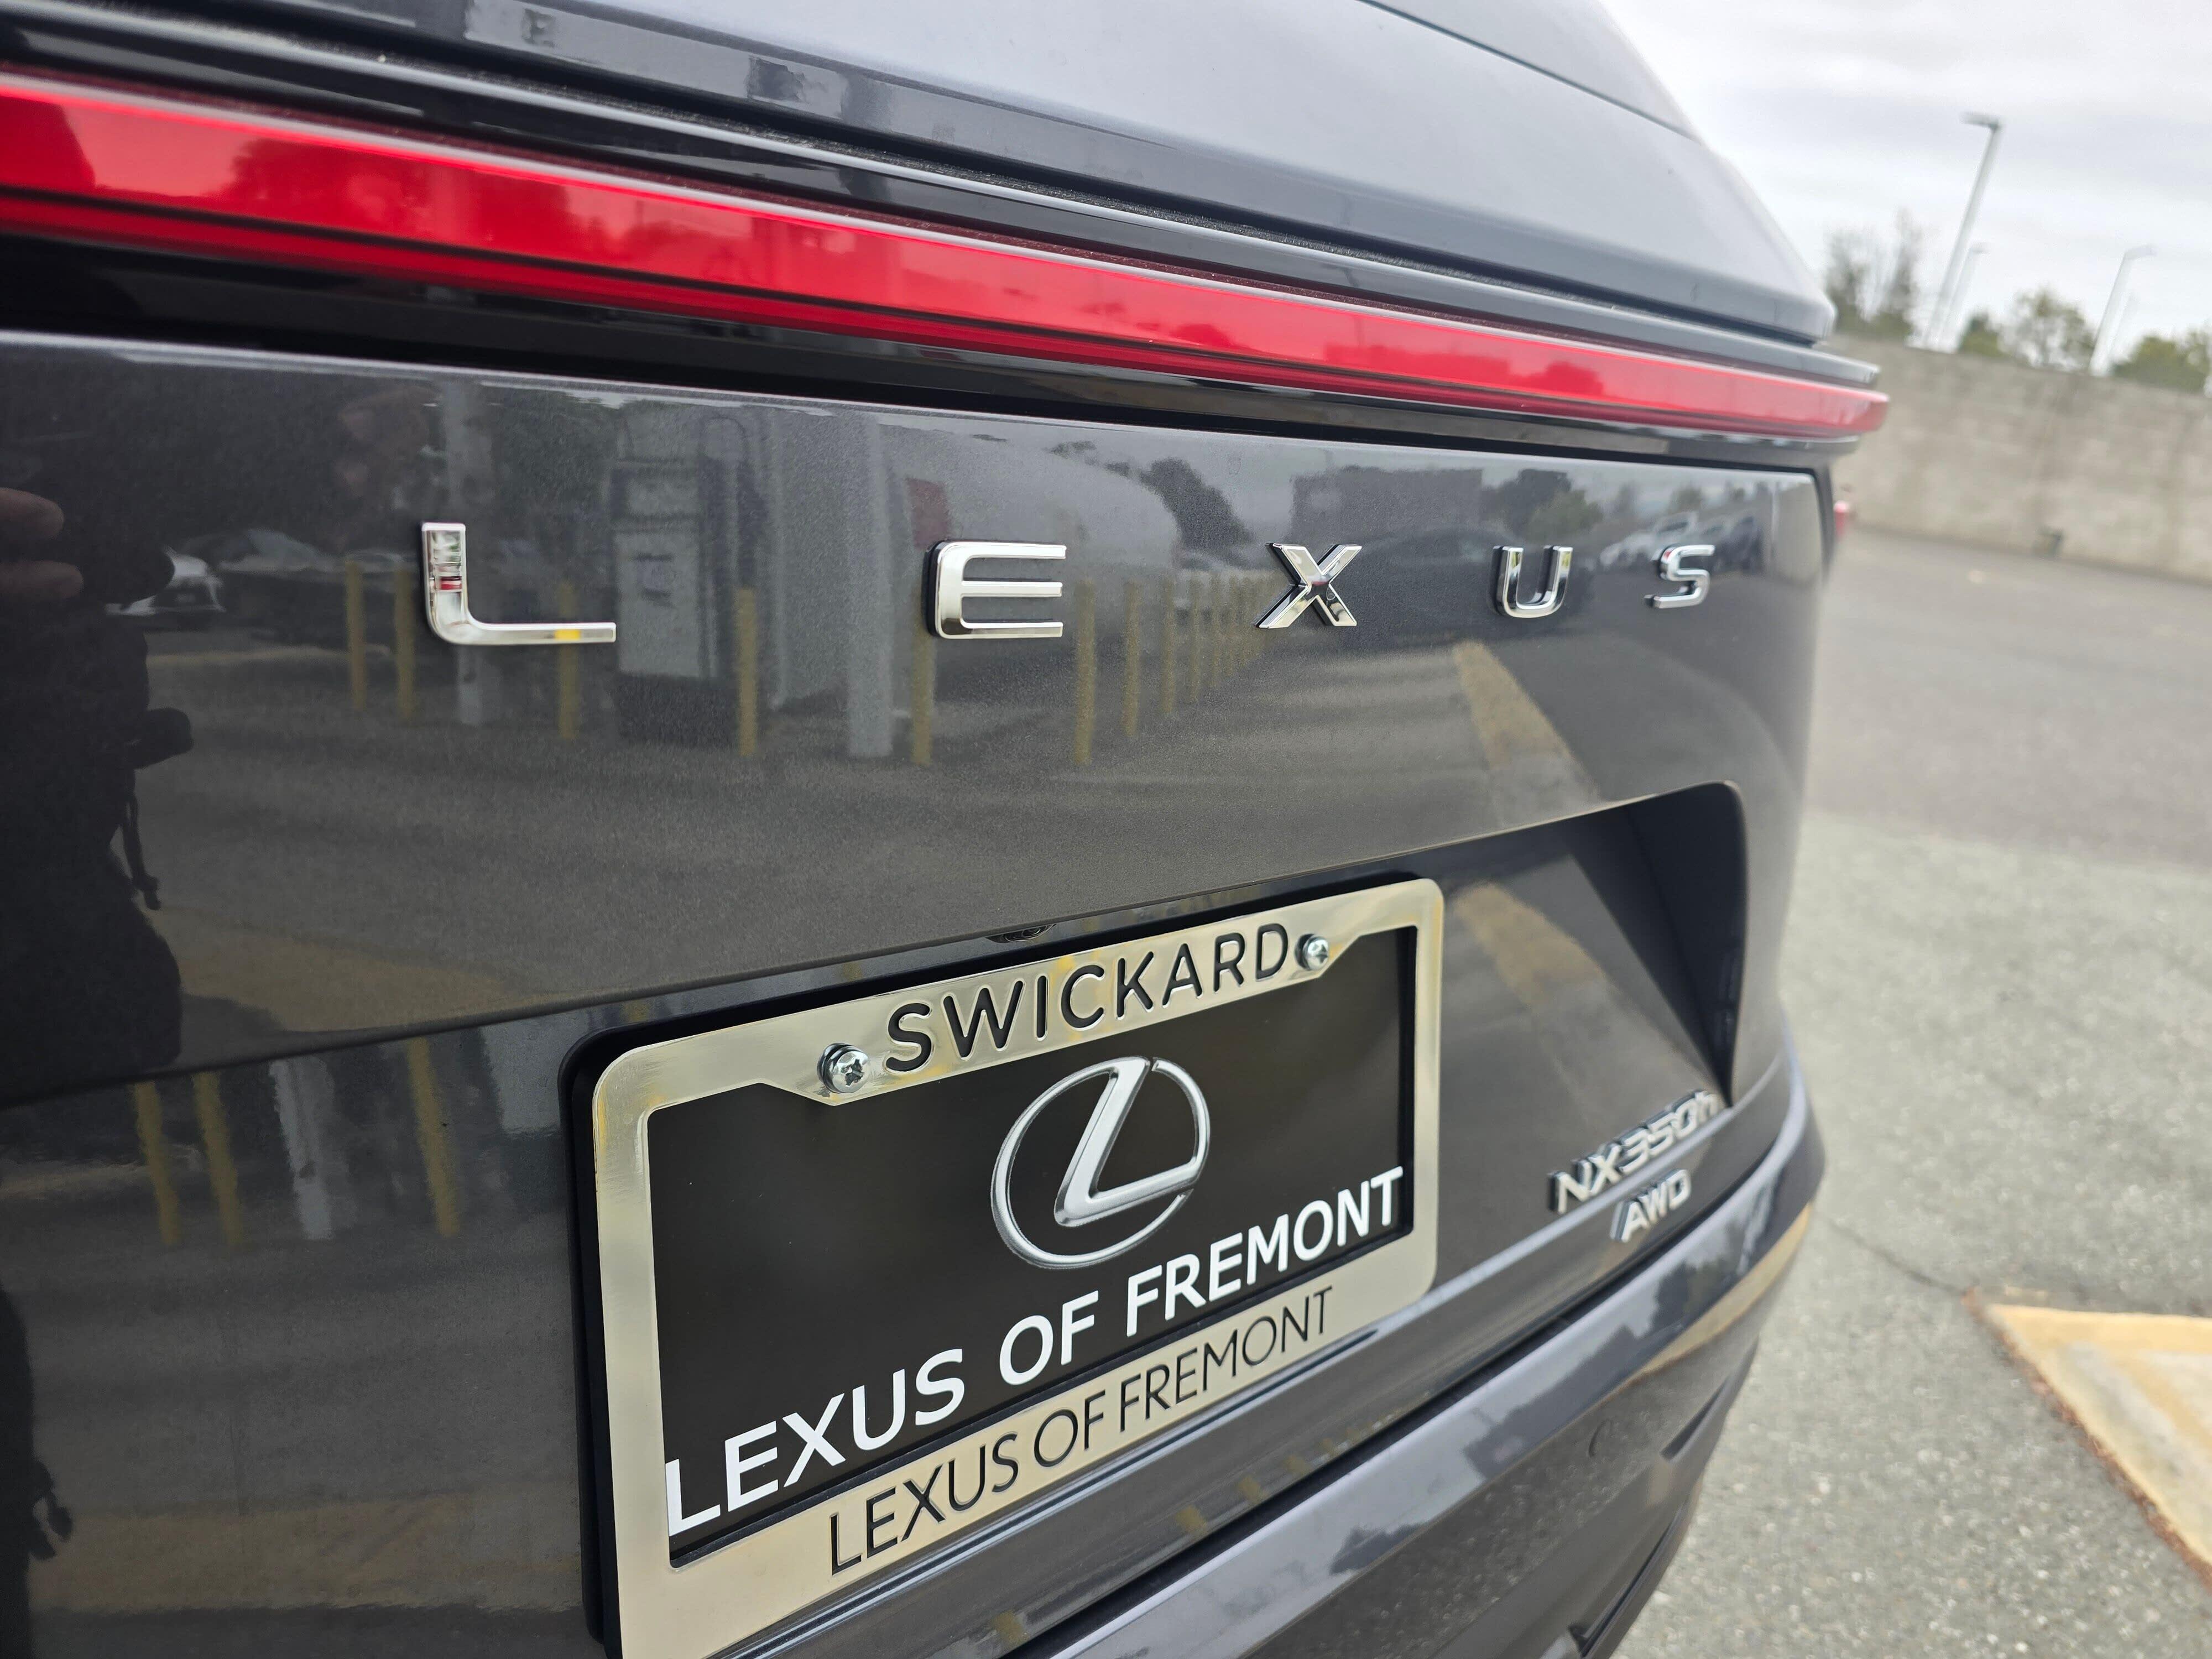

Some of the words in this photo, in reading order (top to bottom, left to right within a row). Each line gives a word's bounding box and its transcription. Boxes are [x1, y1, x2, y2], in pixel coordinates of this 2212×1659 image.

[422, 522, 1715, 645] LEXUS
[884, 922, 1289, 1073] SWICKARD
[1610, 1168, 1691, 1243] AWD
[666, 1348, 964, 1535] LEXUS
[999, 1291, 1099, 1385] OF
[1126, 1167, 1403, 1337] FREMONT
[830, 1433, 1019, 1575] LEXUS
[1034, 1390, 1108, 1467] OF
[1120, 1287, 1333, 1432] FREMONT
